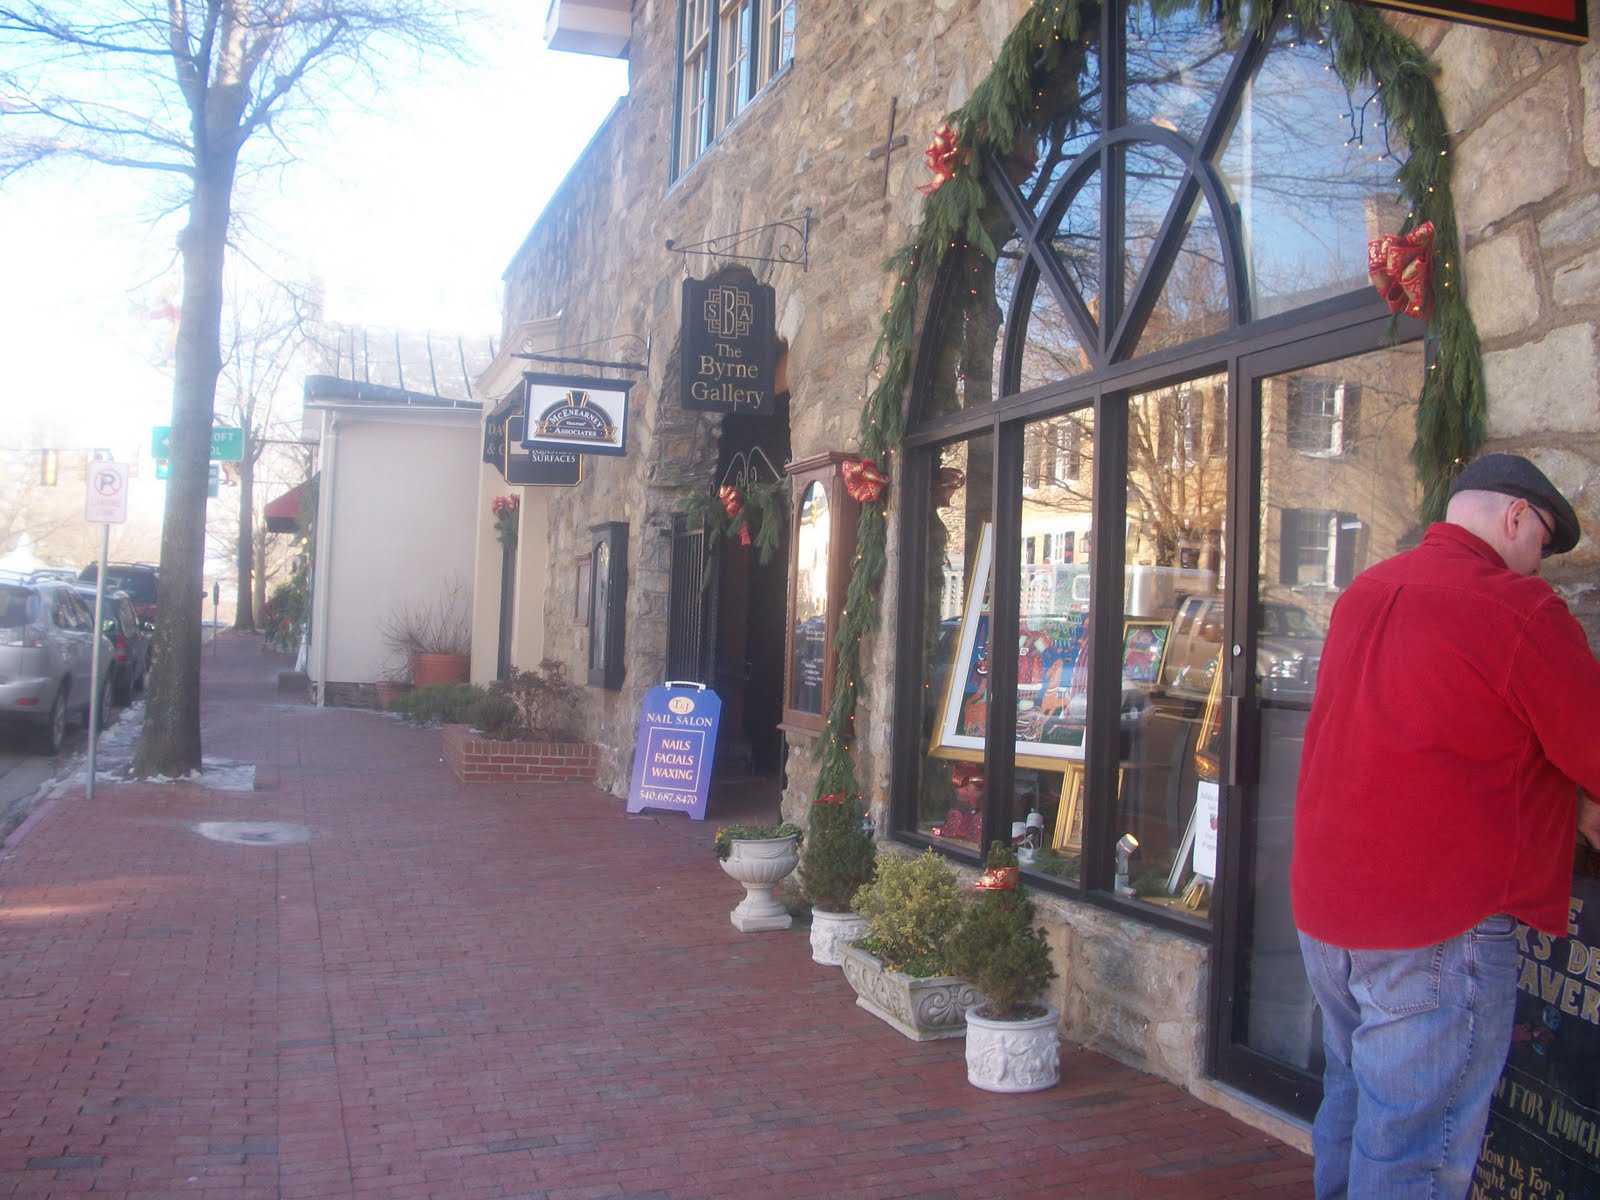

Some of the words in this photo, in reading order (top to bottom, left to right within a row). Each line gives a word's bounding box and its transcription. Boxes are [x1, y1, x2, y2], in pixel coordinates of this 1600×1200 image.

[715, 343, 742, 358] The
[698, 355, 758, 381] Byrne
[691, 381, 765, 409] Gallery
[213, 432, 233, 441] OFT
[554, 427, 597, 437] ASSOCIATES
[532, 453, 576, 463] SURFACES
[646, 713, 672, 724] NAIL
[676, 716, 713, 727] SALON
[662, 739, 691, 751] NAILS
[655, 753, 694, 766] FACIALS
[652, 767, 693, 780] WAXING
[640, 790, 697, 805] 540.687.8470
[1567, 940, 1600, 985] DE
[1510, 1082, 1543, 1126] FOR
[1547, 1099, 1600, 1159] LUNCH
